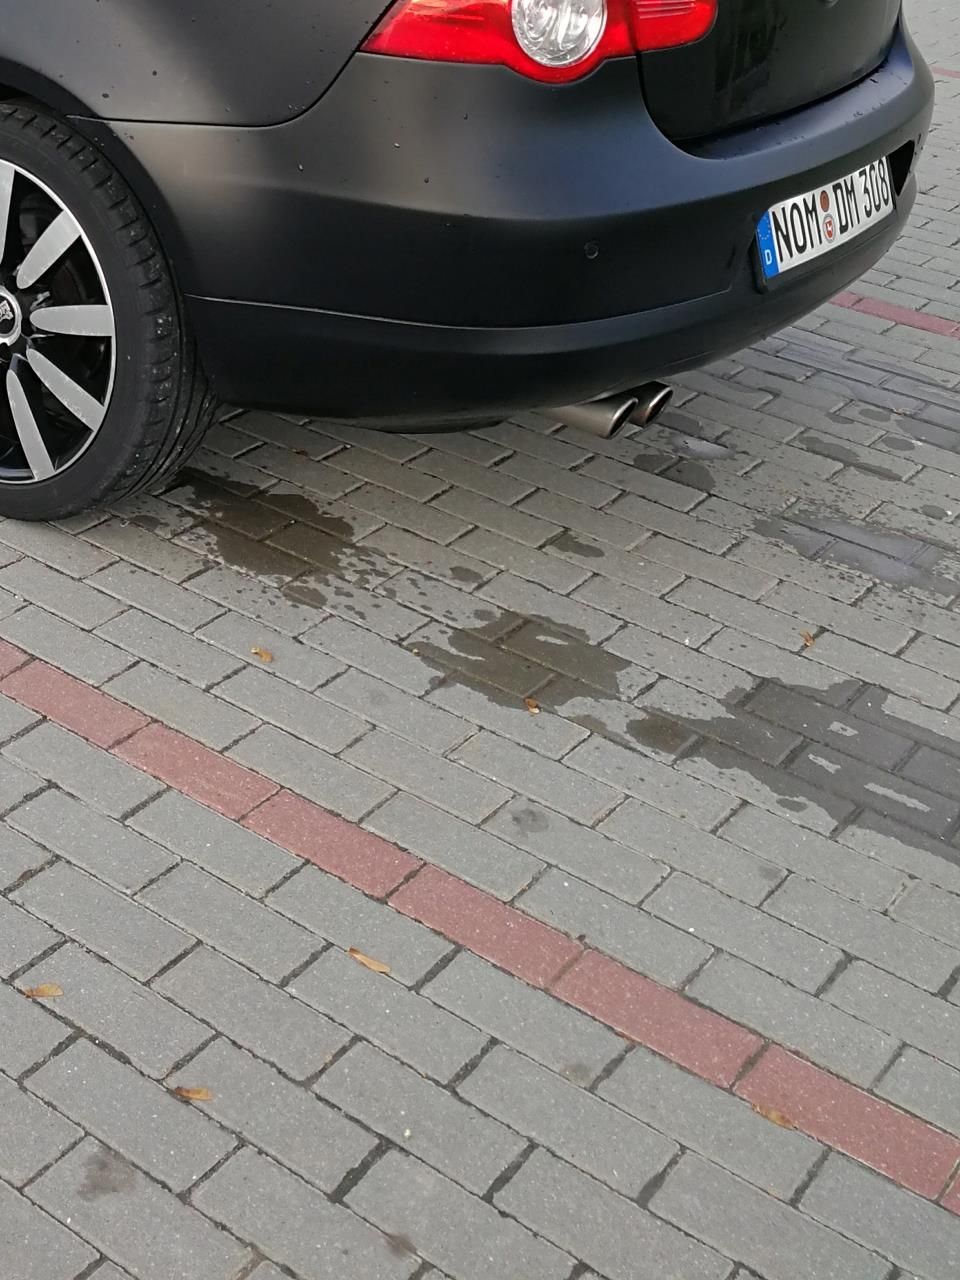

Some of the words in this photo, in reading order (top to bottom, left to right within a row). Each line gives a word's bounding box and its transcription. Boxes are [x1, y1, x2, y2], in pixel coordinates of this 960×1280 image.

[771, 193, 823, 263] NOM
[831, 176, 861, 235] DM
[858, 159, 890, 219] 308
[764, 249, 773, 266] D
